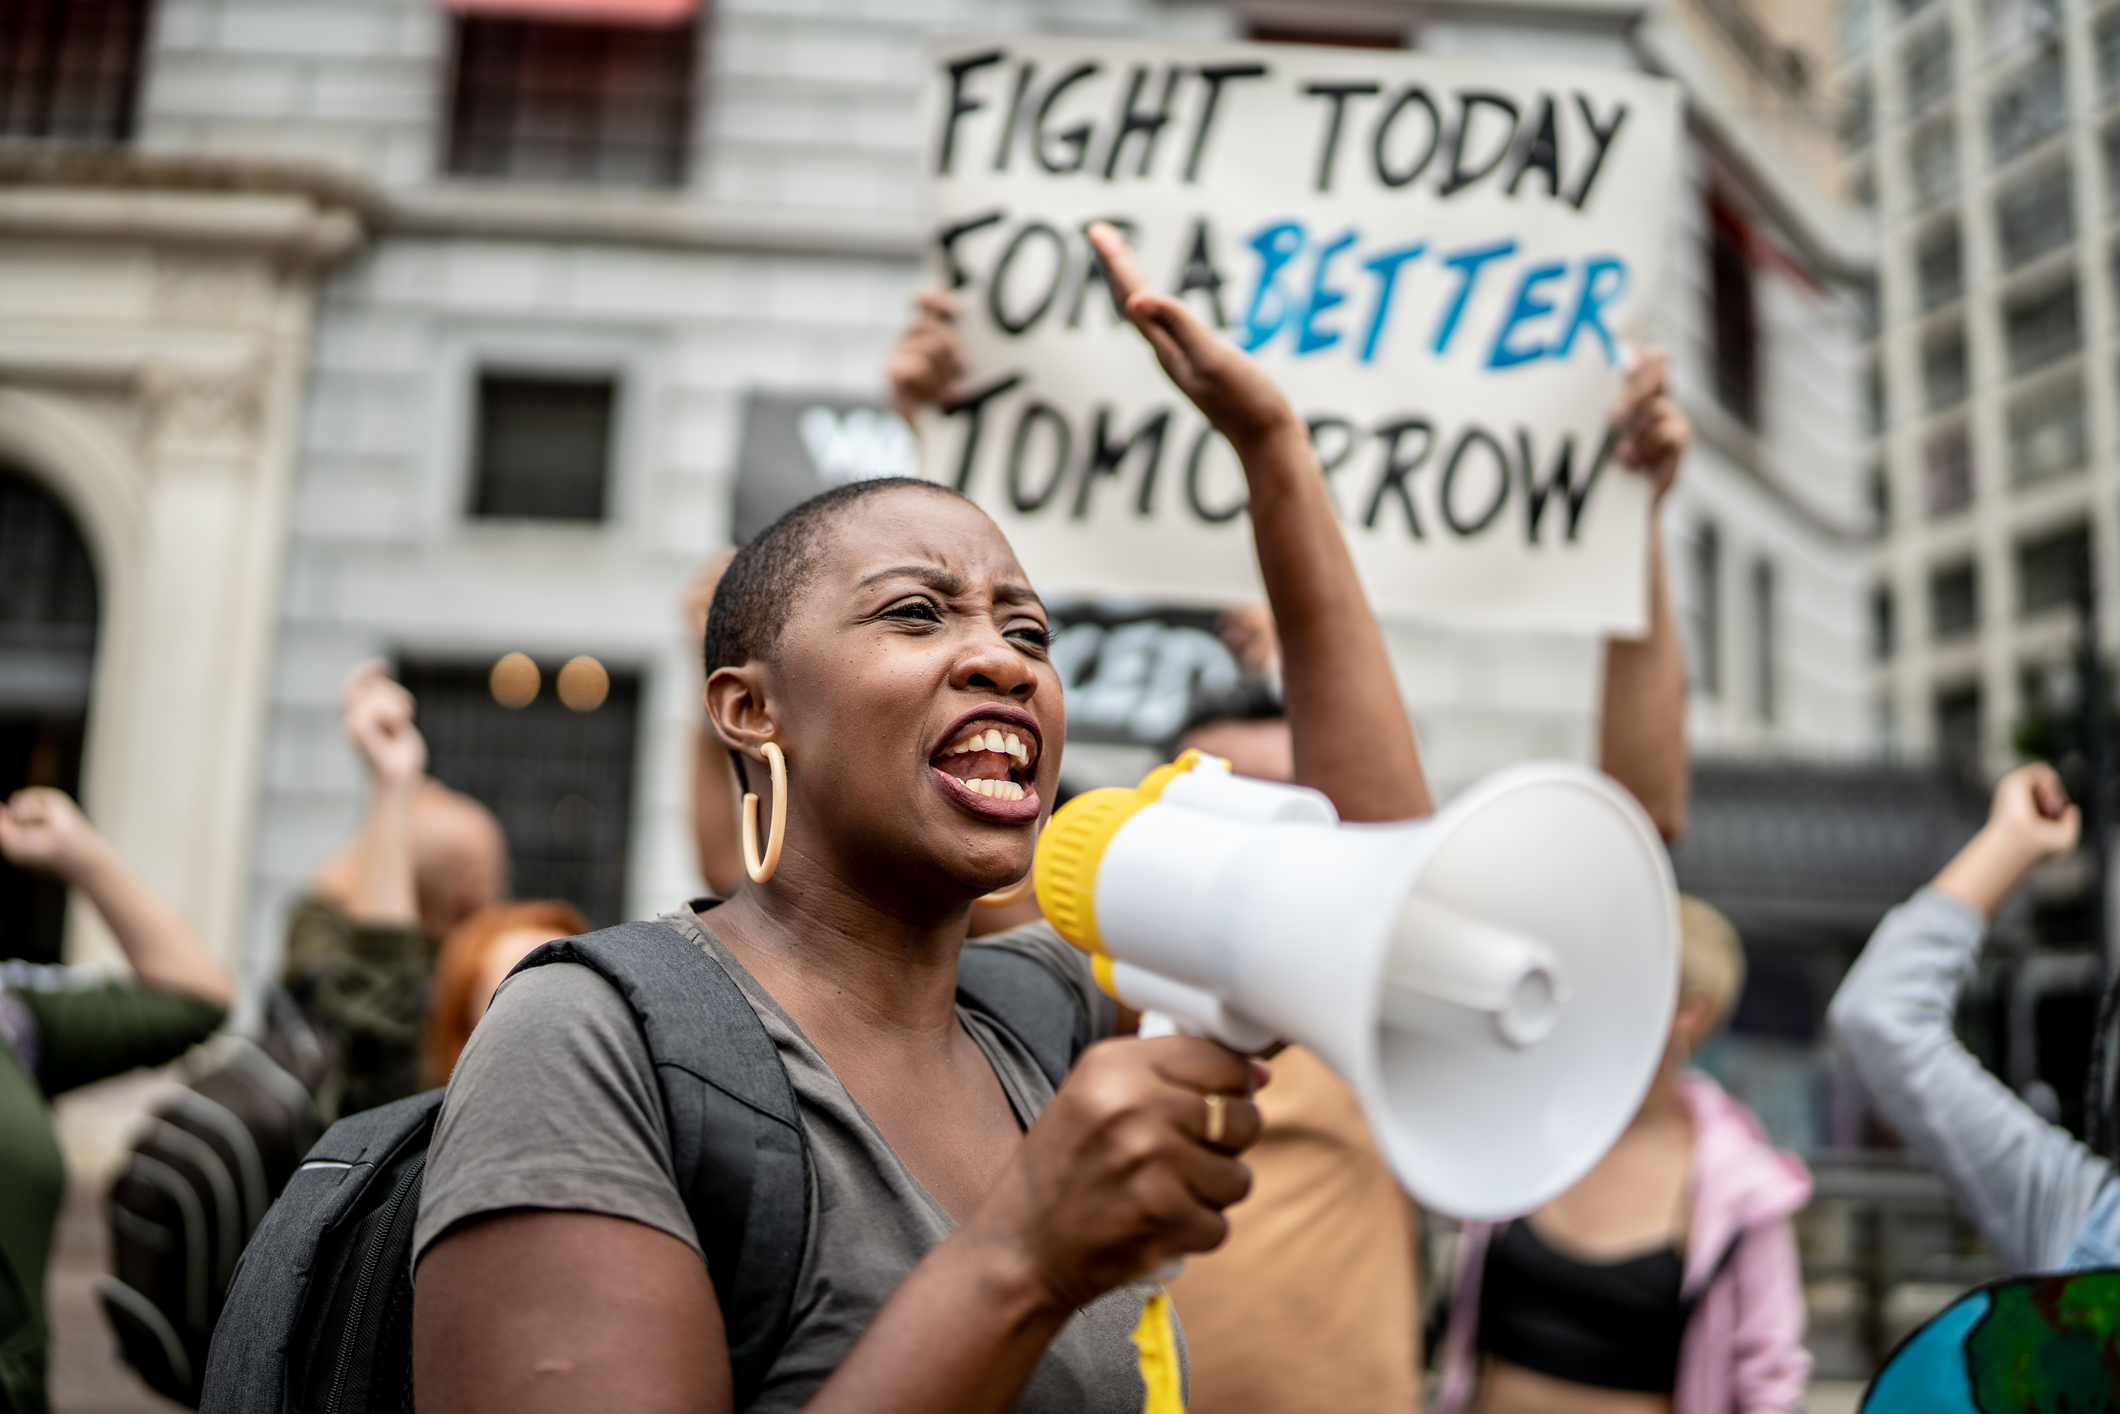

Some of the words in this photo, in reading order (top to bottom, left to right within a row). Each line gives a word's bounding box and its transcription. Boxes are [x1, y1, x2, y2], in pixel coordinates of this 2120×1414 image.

[935, 50, 1270, 183] FIGHT
[1298, 82, 1628, 210] TODAY
[938, 207, 1139, 336] FOR
[1175, 212, 1229, 331] A
[1237, 219, 1628, 371] BETTER
